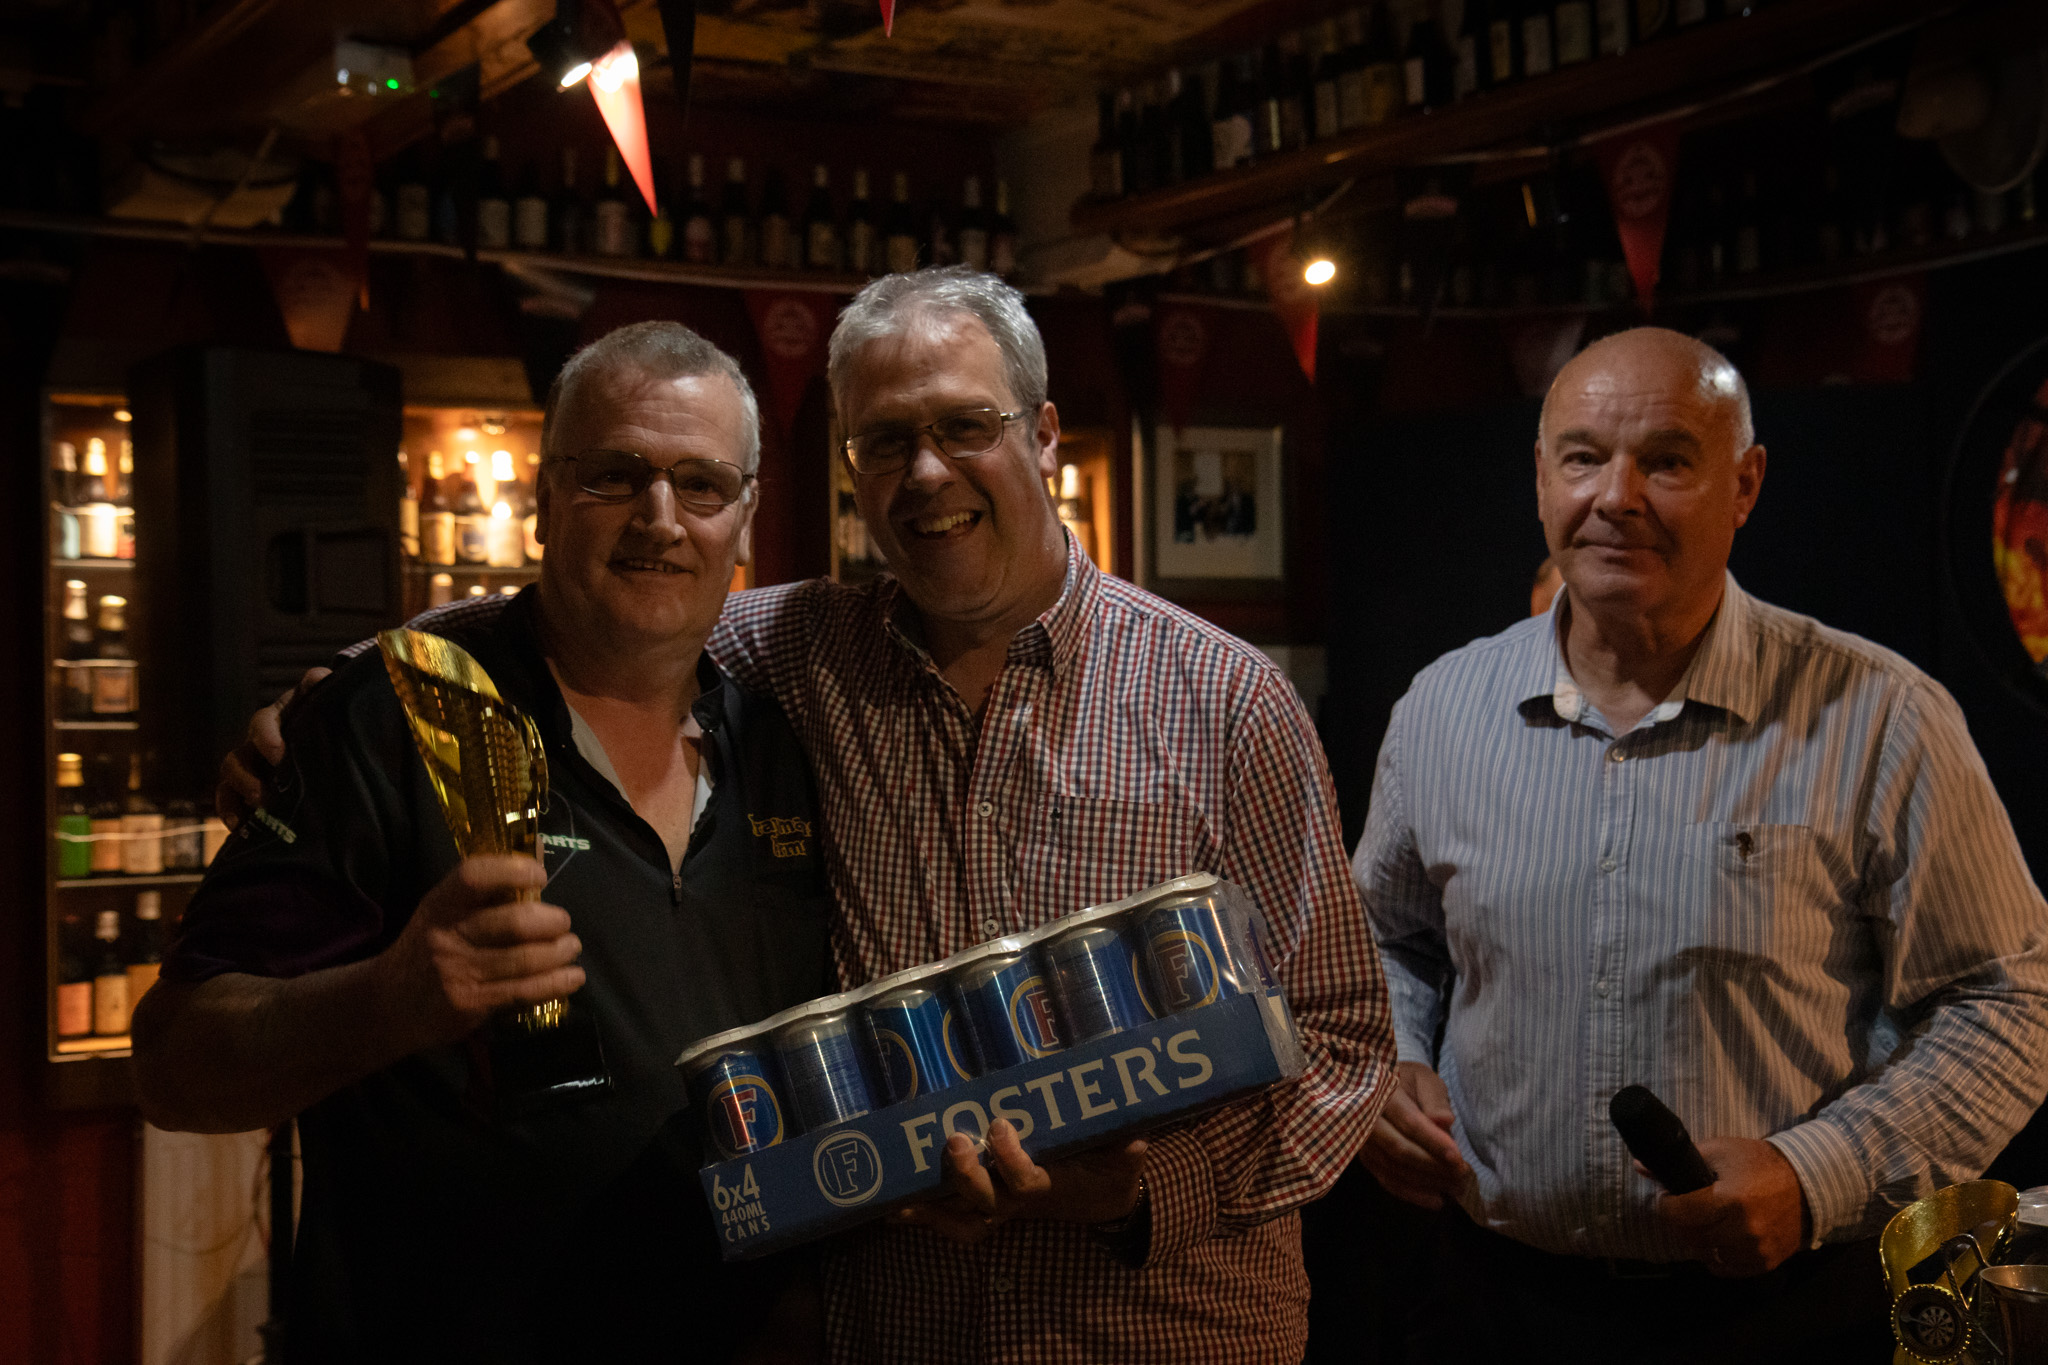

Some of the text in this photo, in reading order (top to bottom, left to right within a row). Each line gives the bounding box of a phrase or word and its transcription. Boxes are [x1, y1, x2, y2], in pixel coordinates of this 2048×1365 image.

[721, 1088, 758, 1150] F
[899, 1029, 1214, 1174] FOSTER'S
[713, 1163, 760, 1211] 6x4
[826, 1141, 859, 1196] F
[721, 1200, 767, 1227] 440ML
[724, 1215, 771, 1243] CANS
